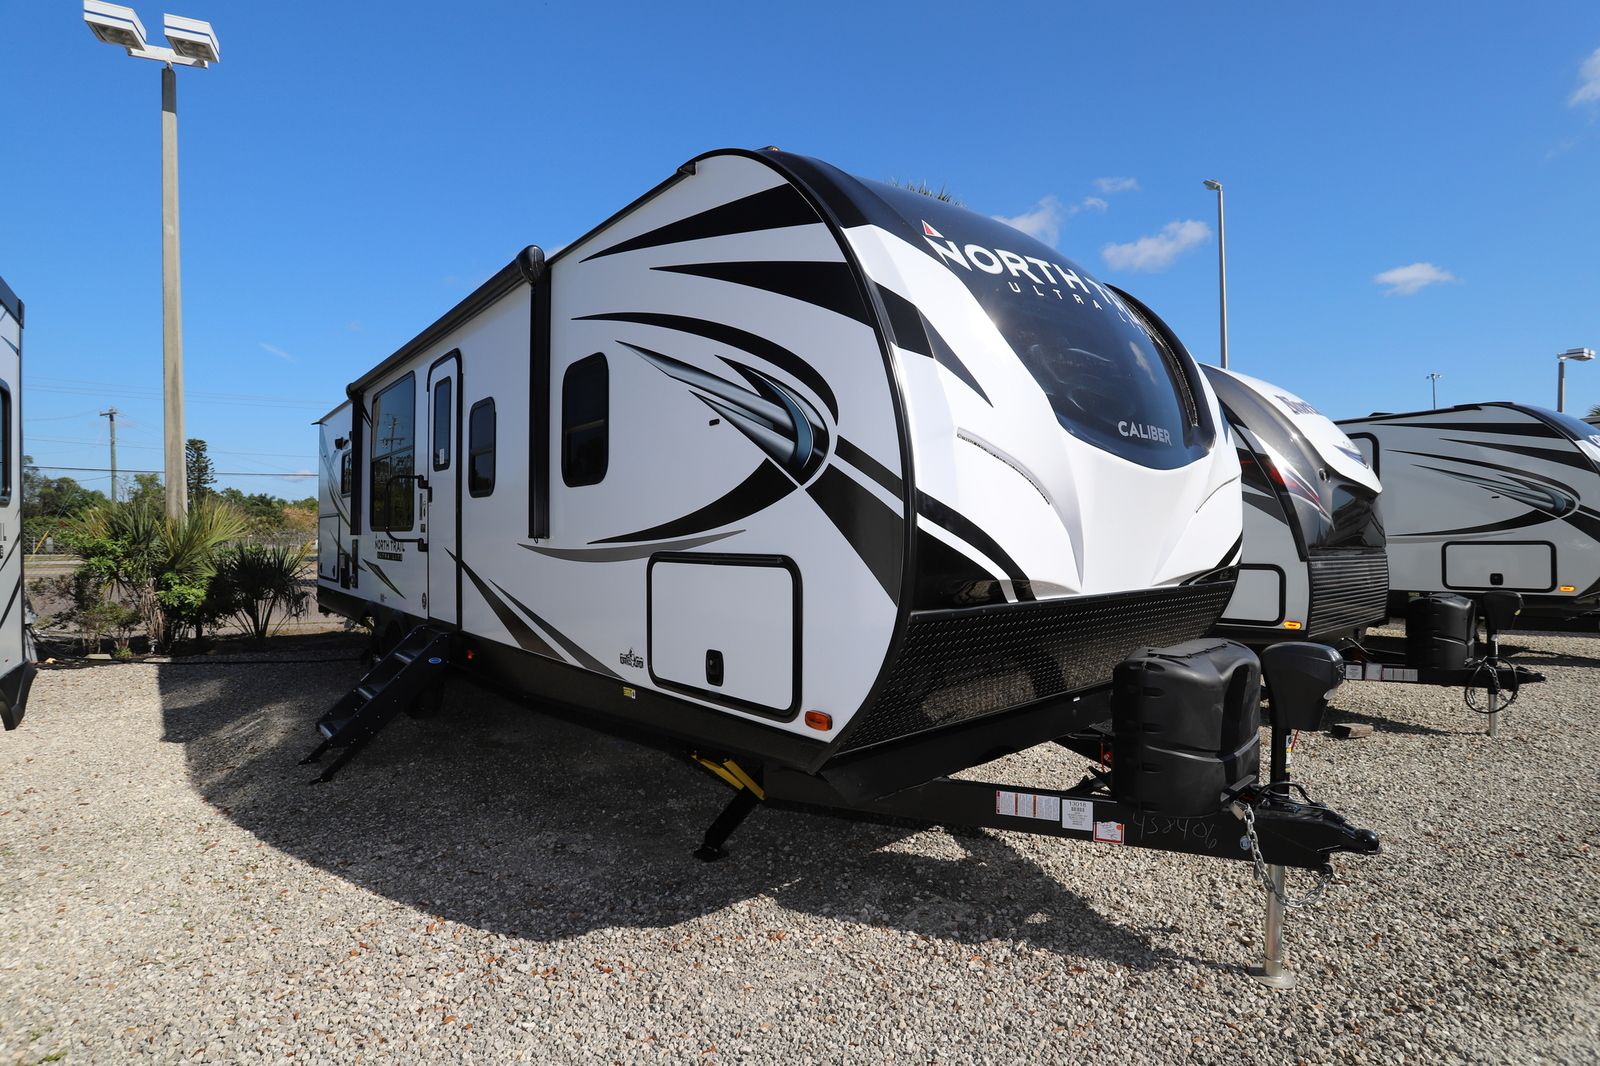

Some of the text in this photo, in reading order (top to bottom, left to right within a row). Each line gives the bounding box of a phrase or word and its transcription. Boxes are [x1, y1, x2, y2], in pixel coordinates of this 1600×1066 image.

[922, 234, 1092, 295] NORTH
[1008, 281, 1103, 311] ULTRA
[1117, 420, 1173, 446] CALIBER
